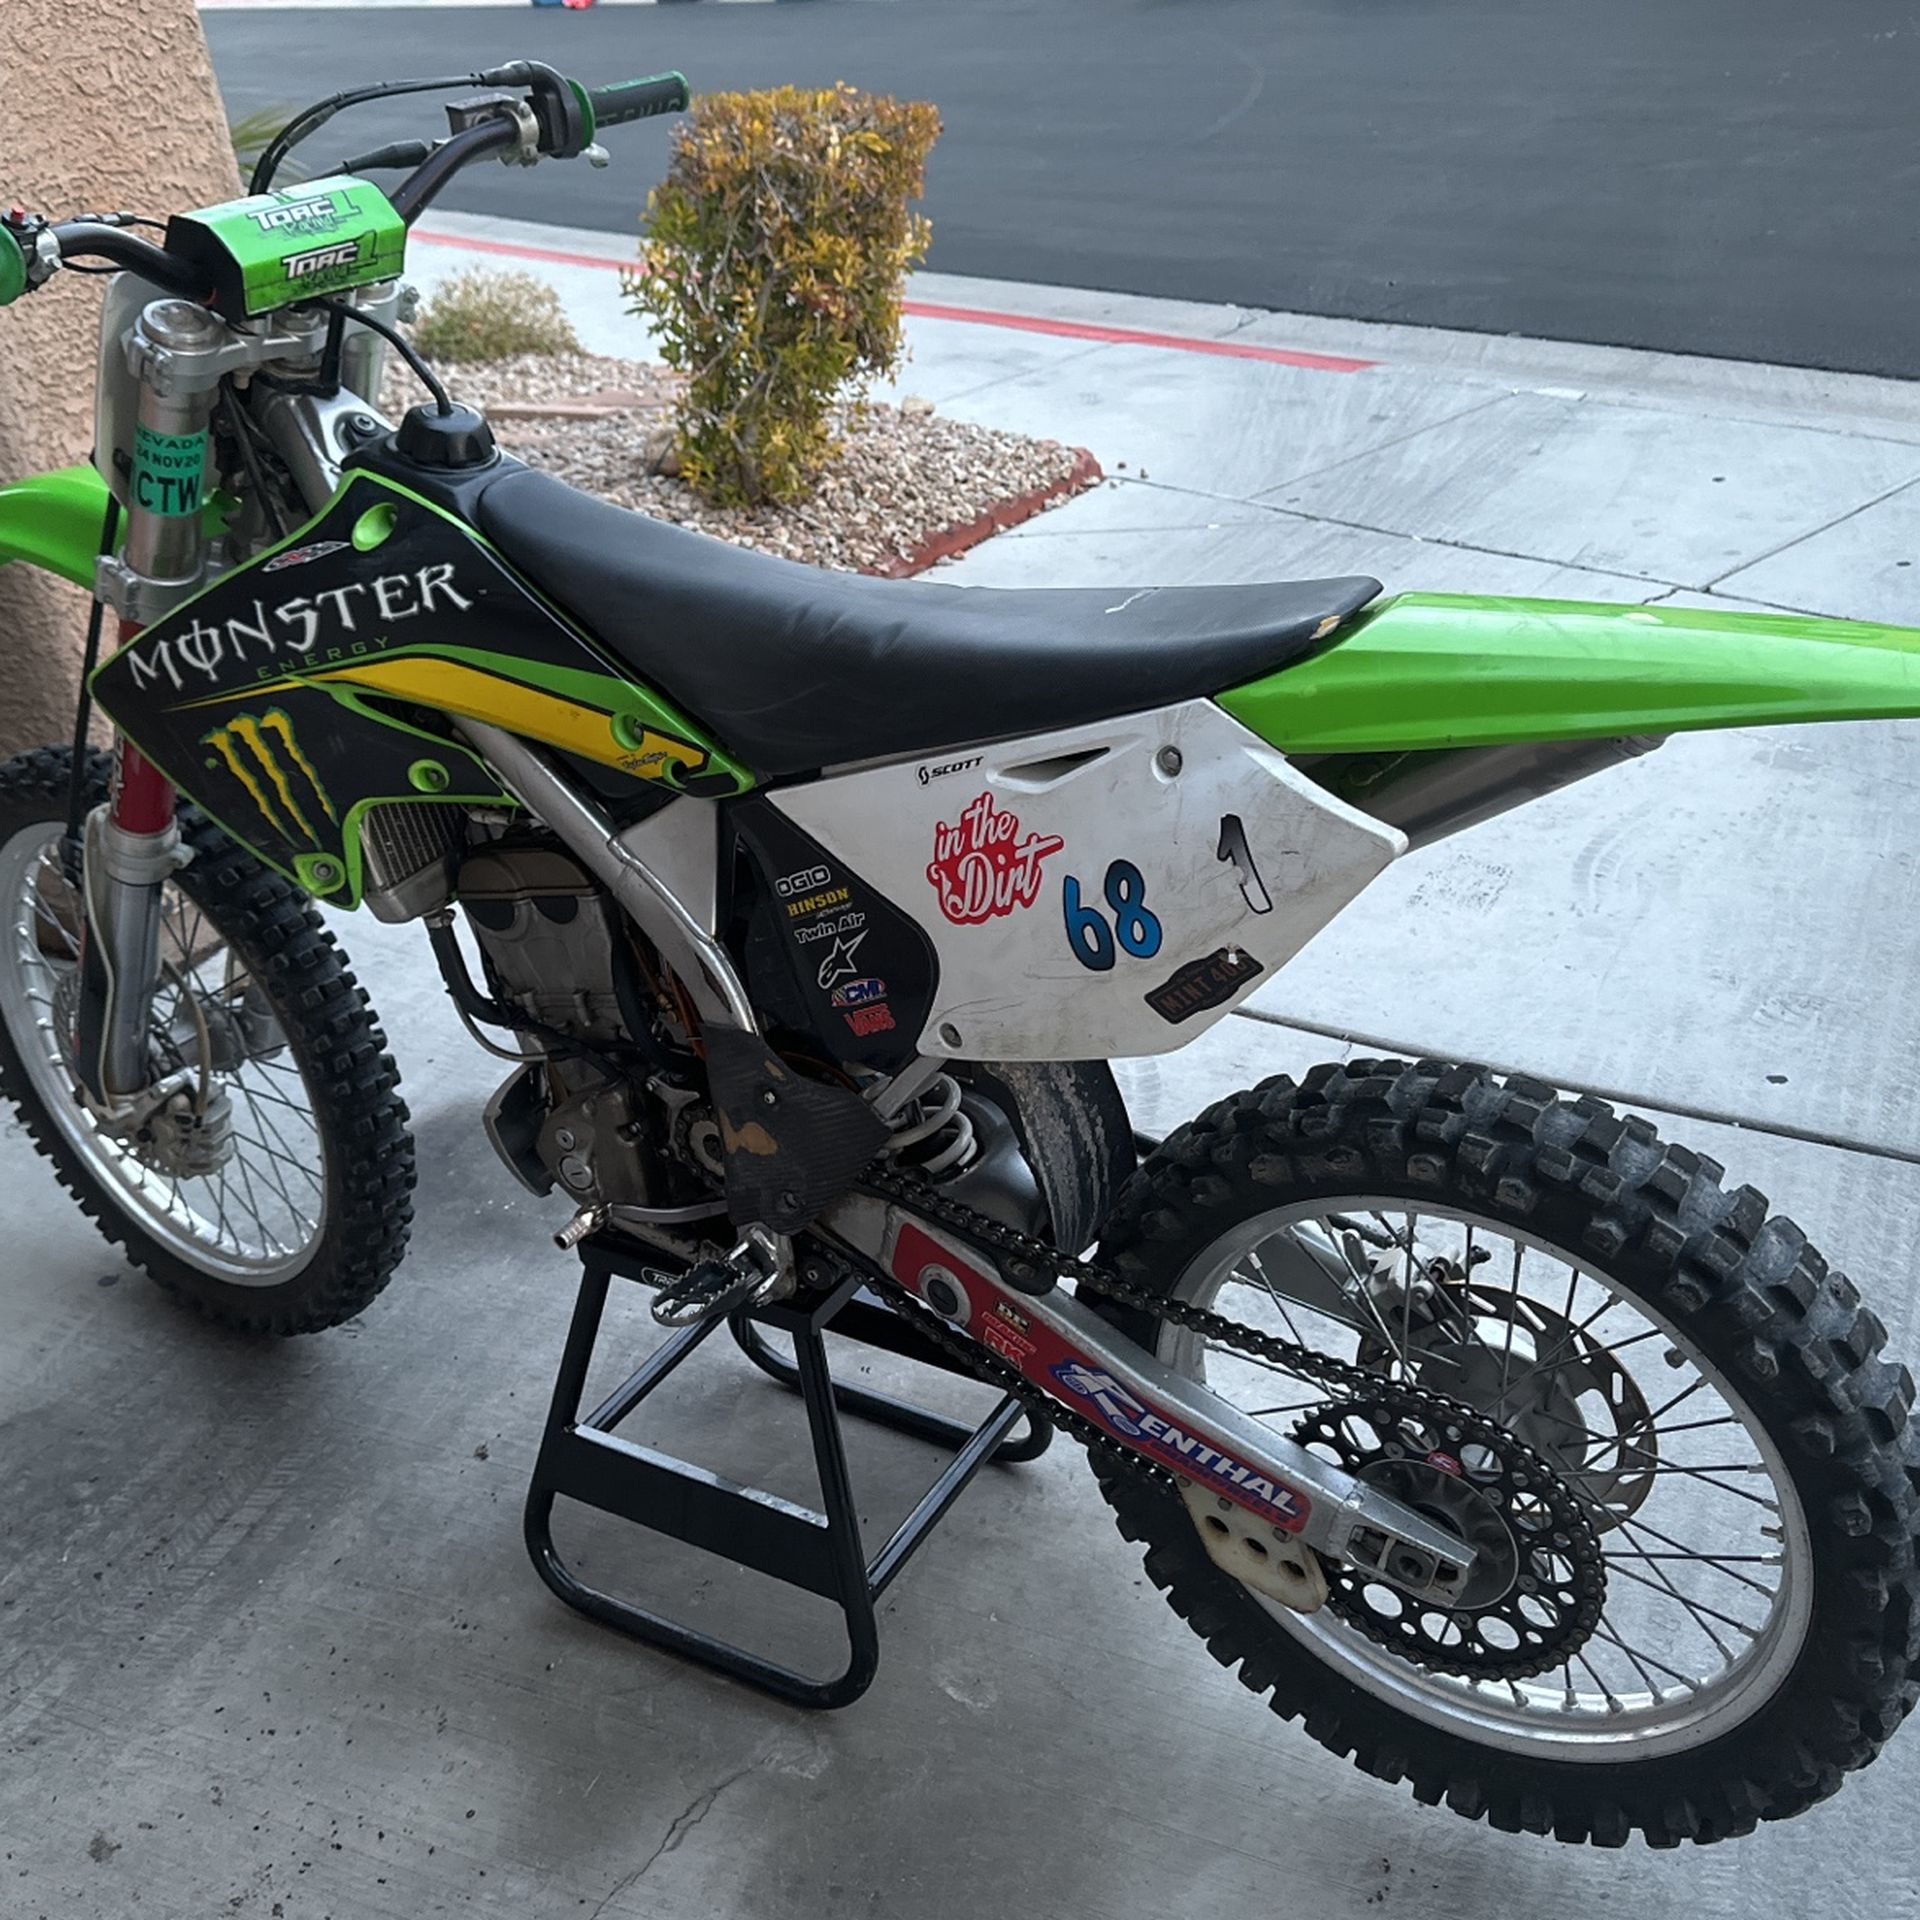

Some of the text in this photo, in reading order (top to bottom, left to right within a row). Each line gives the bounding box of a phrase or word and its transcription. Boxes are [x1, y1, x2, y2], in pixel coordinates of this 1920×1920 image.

[127, 562, 474, 691] MONSTER
[256, 635, 391, 681] ENERGY
[931, 756, 985, 779] SCOTT
[935, 795, 1014, 861] in the
[775, 864, 831, 897] OGIO
[931, 836, 1063, 918] Dirt
[1217, 813, 1274, 915] 1
[787, 887, 850, 918] HINSON
[794, 911, 866, 944] Twin Air
[1063, 858, 1163, 972] 68
